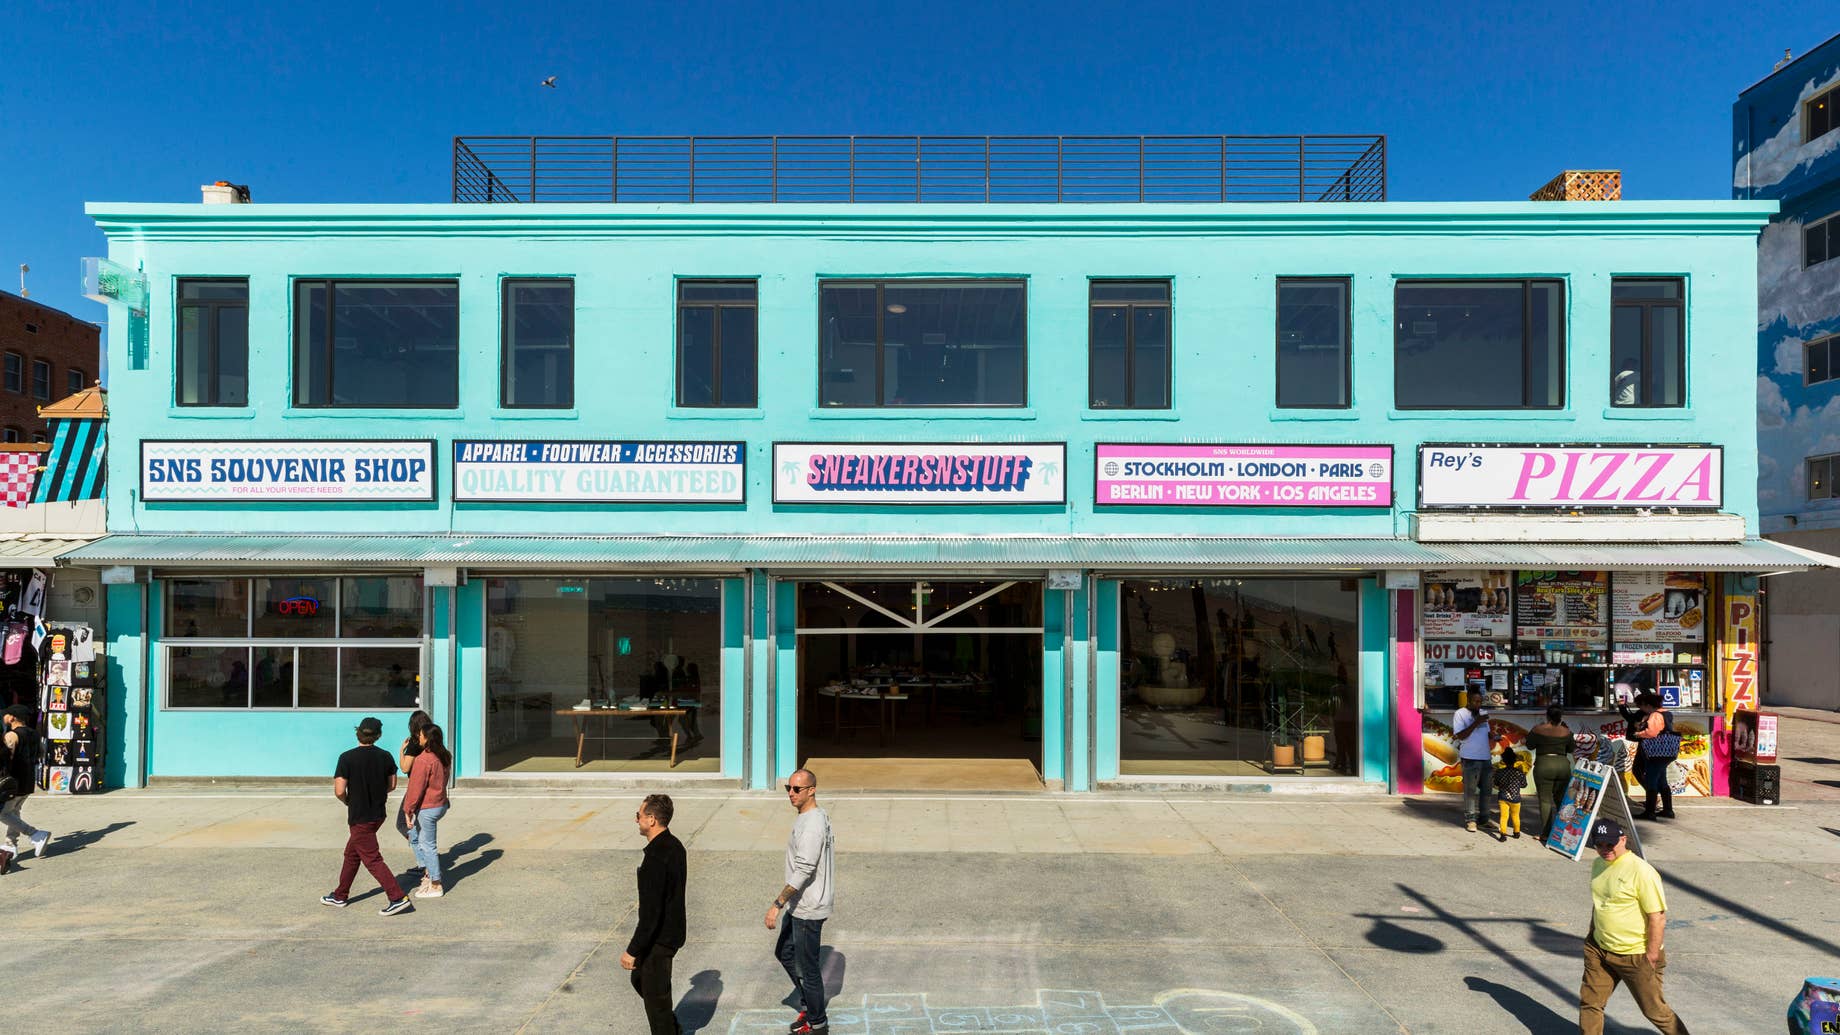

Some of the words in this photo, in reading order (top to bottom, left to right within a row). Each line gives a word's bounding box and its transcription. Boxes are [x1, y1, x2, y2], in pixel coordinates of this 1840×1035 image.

[462, 444, 527, 461] APPAREL
[541, 444, 621, 462] FOOTWEAR
[635, 444, 736, 462] ACCESSORIES
[1430, 452, 1482, 471] Rey's
[149, 458, 202, 483] SNS
[211, 458, 346, 483] SOUVENIR
[355, 458, 426, 483] SHOP
[807, 455, 1032, 491] SNEAKERSNSTUFF
[1124, 461, 1225, 476] STOCKHOLM
[1237, 462, 1306, 477] LONDON
[1319, 463, 1364, 477] PARIS
[1507, 452, 1713, 500] PIZZA
[462, 468, 566, 495] QUALITY
[576, 469, 737, 494] GUARANTEED
[1110, 484, 1163, 500] BERLIN
[1176, 485, 1212, 500] NEW
[1216, 485, 1261, 501] YORK
[1274, 485, 1304, 501] LOS
[1308, 486, 1377, 501] ANGELES
[279, 600, 317, 616] OPEN
[1424, 644, 1451, 660] HOT
[1456, 644, 1495, 661] DOGS
[1601, 720, 1625, 734] SOFT
